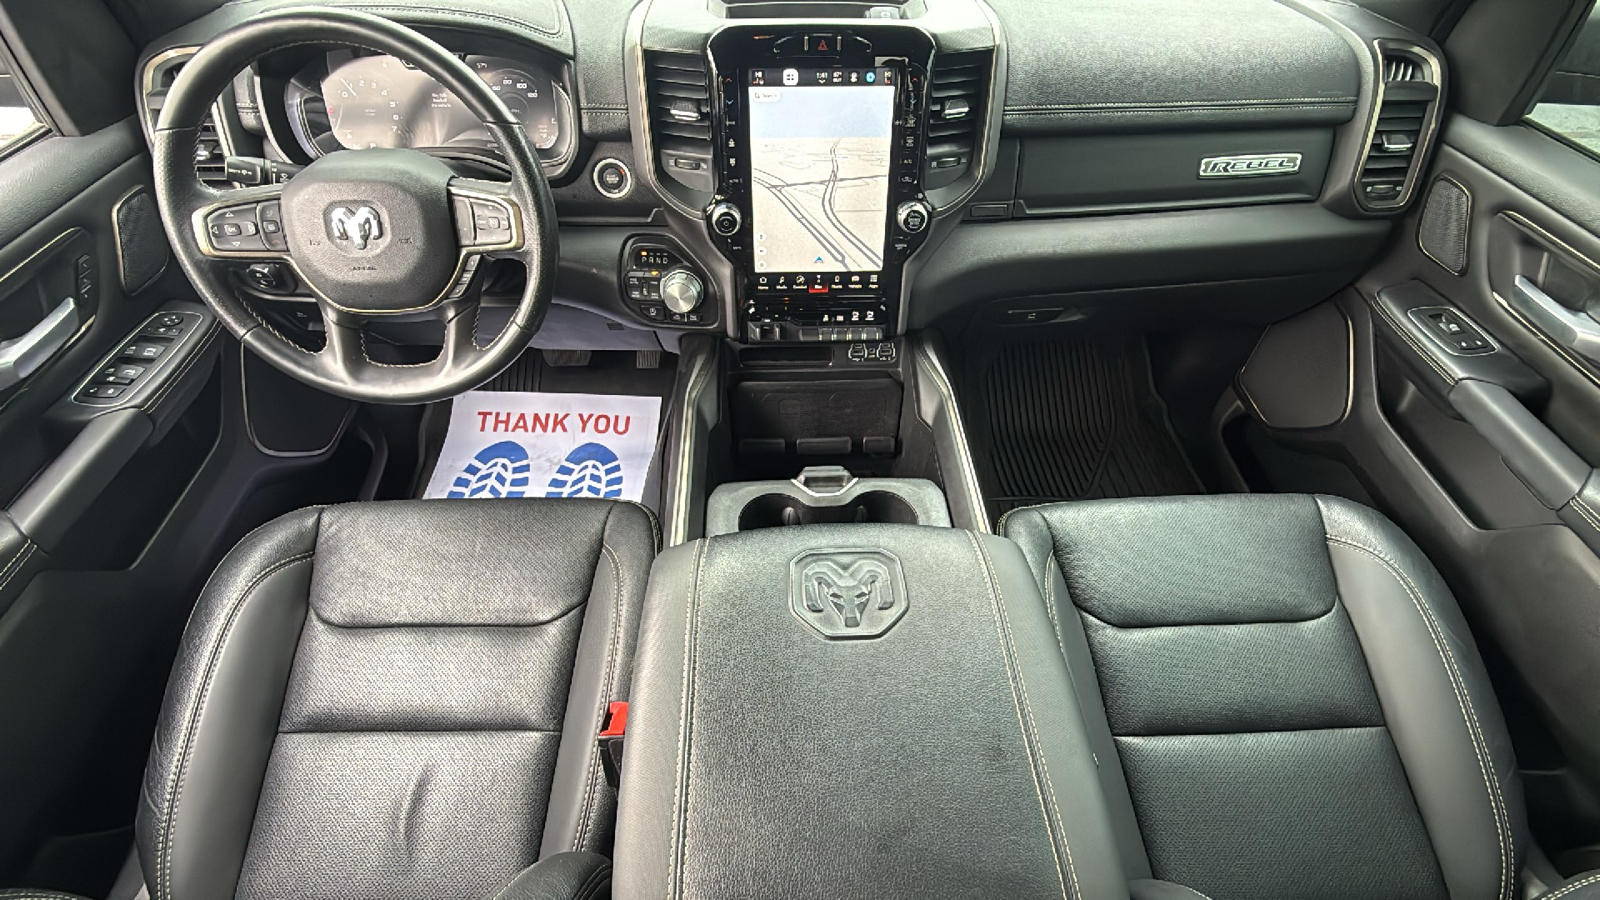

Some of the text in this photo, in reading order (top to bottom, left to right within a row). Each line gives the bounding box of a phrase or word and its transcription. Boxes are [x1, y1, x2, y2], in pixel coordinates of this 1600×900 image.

[1208, 158, 1294, 173] REBEL
[477, 411, 632, 436] THANK YOU
